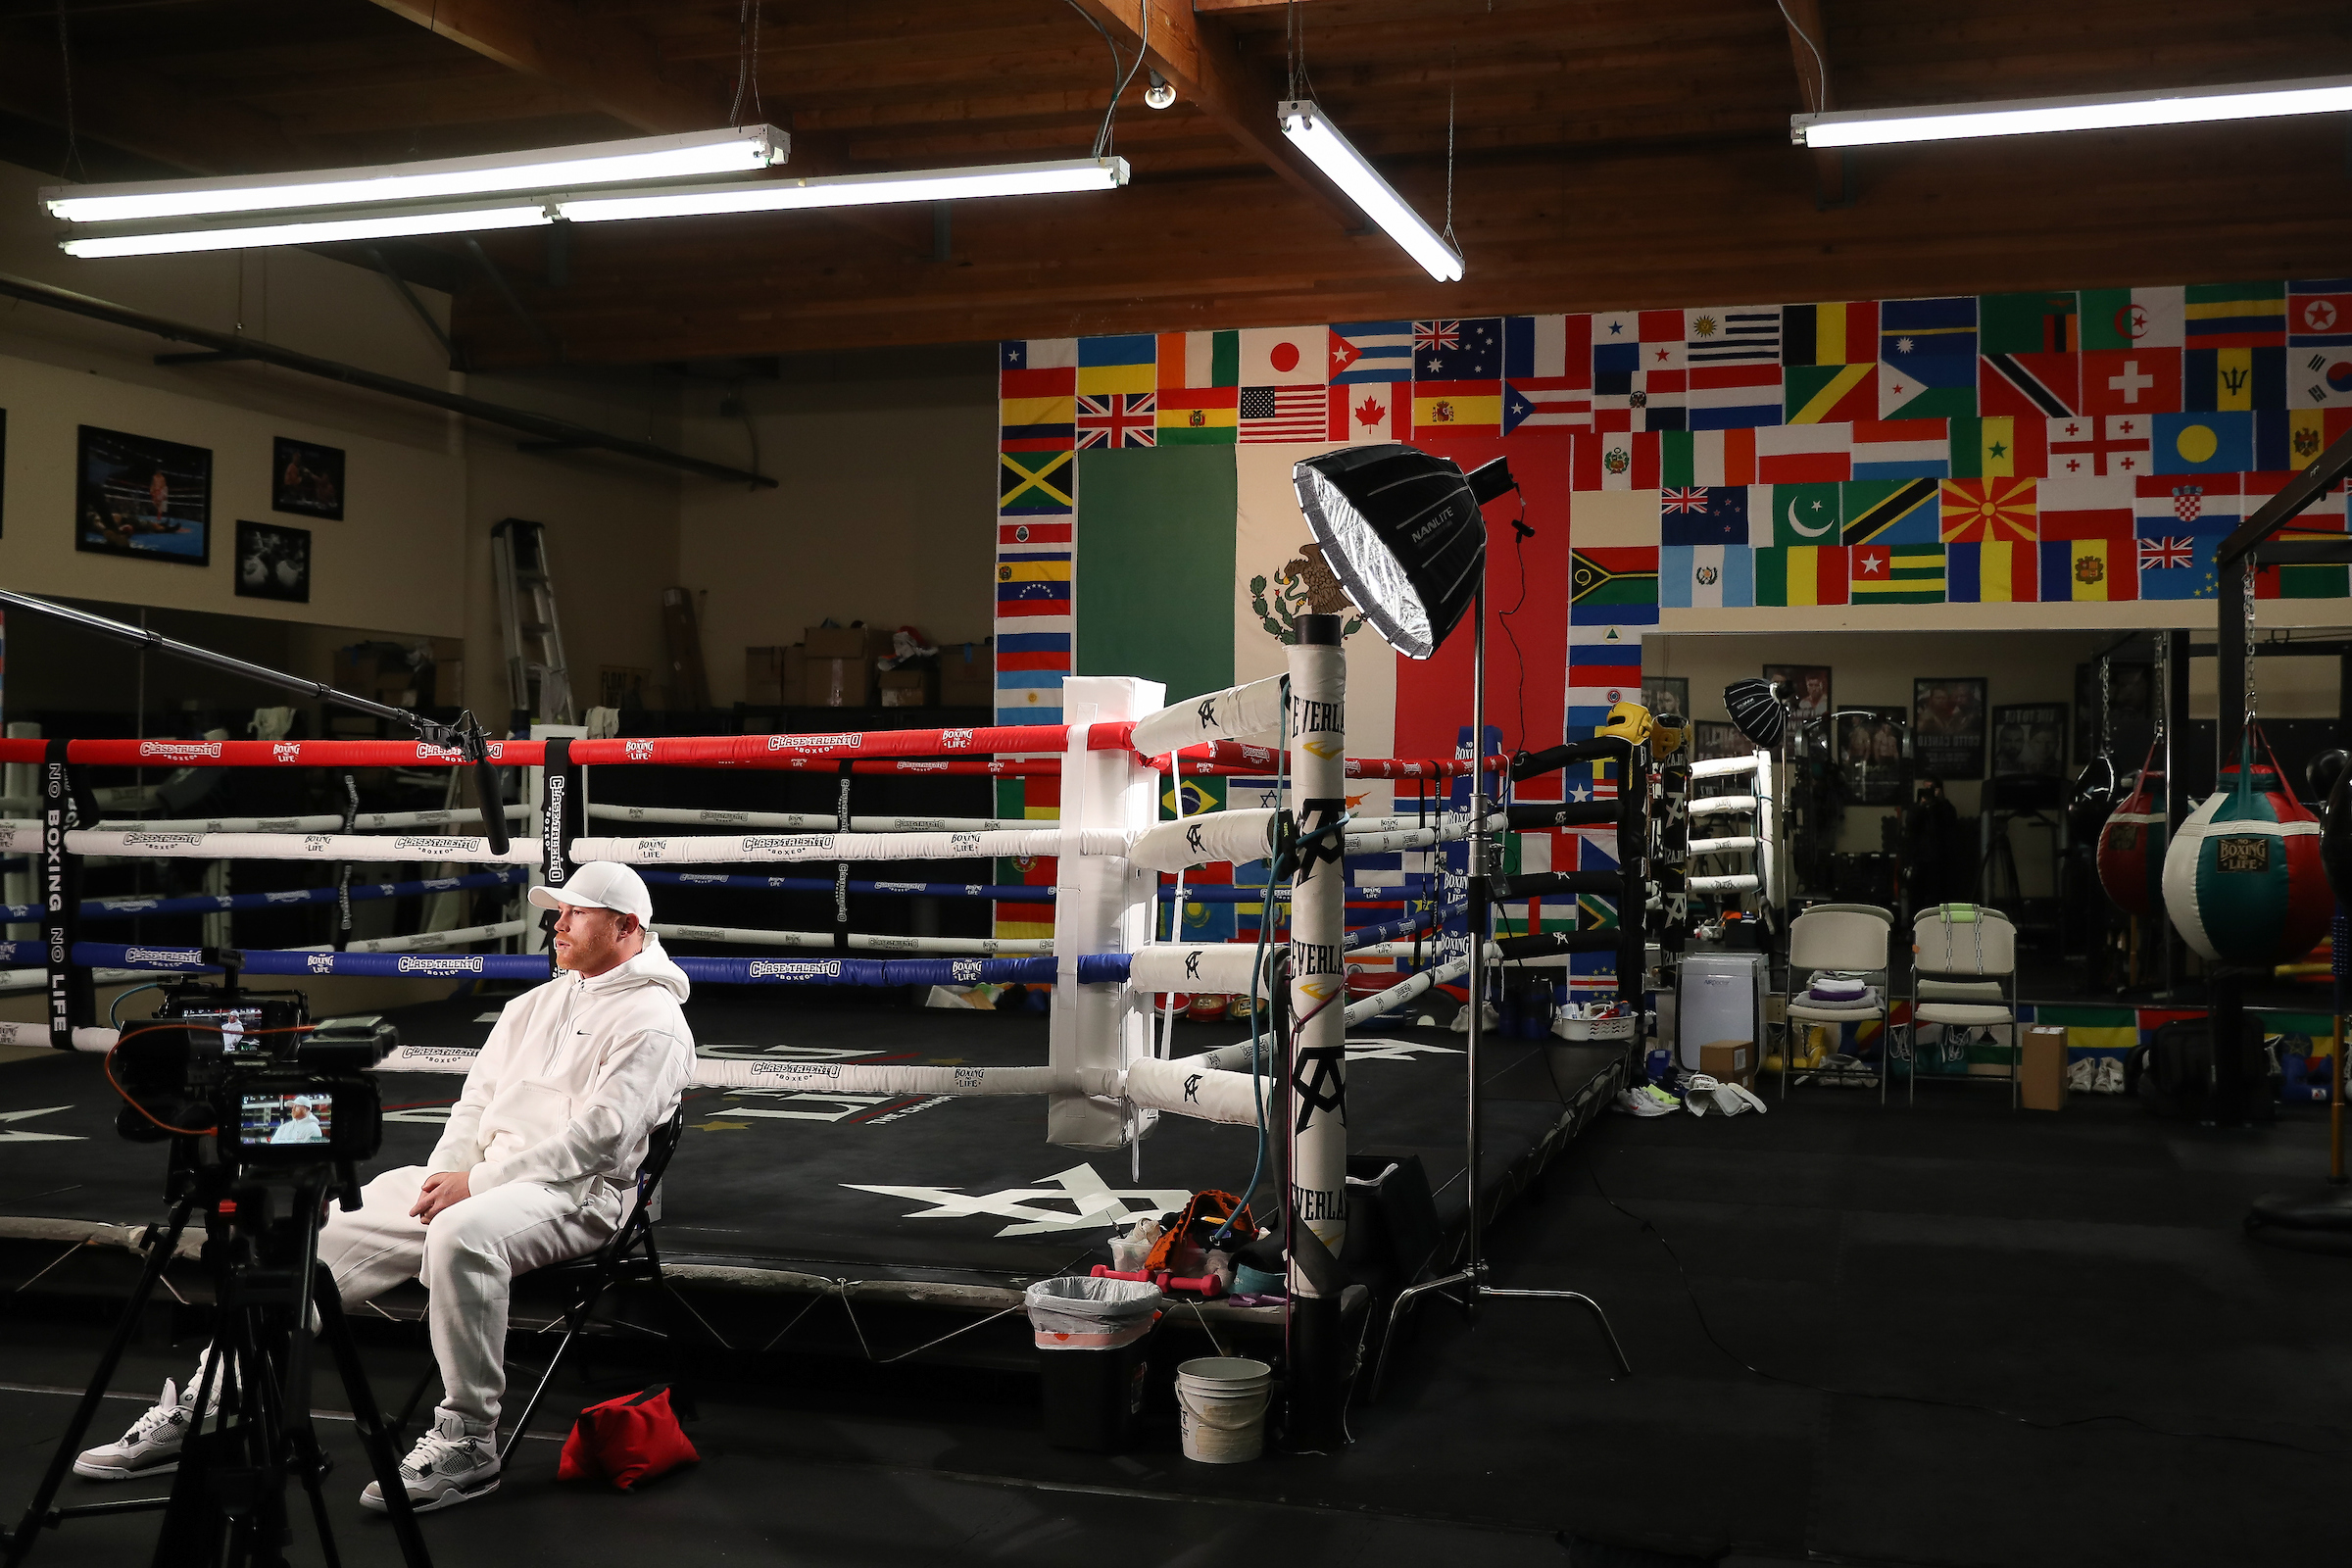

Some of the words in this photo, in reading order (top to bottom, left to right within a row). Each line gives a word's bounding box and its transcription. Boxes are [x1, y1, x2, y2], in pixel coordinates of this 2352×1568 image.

[1411, 506, 1454, 543] NANLITE
[942, 728, 973, 740] BOXING
[625, 741, 654, 752] BOXING
[948, 740, 966, 749] LIFE
[50, 763, 61, 798] NO
[638, 840, 667, 850] BOXING
[2220, 842, 2266, 858] BOXING
[47, 809, 62, 911] BOXING
[2229, 858, 2258, 869] LIFE
[51, 928, 65, 962] NO
[953, 960, 982, 972] BOXING
[52, 974, 67, 1031] LIFE
[955, 1068, 985, 1078] BOXING
